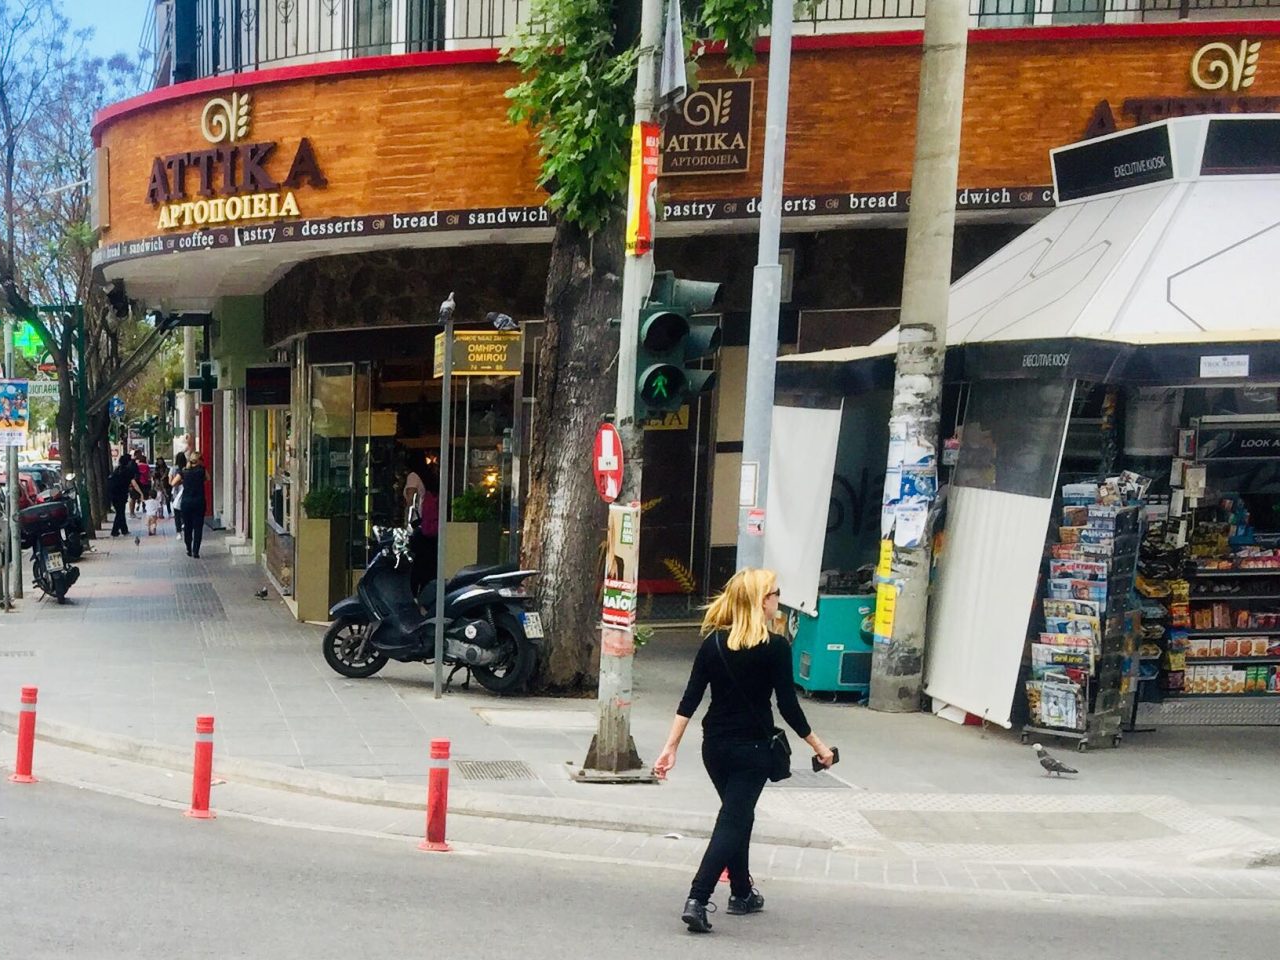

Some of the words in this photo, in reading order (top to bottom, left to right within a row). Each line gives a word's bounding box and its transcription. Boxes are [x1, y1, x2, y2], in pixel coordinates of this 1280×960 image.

[157, 191, 300, 229] ΑΡΤΟΠΟΙΕΙΑ
[663, 202, 716, 221] pastry
[746, 197, 817, 213] deerts
[849, 189, 898, 208] bread
[959, 188, 1011, 205] dwich
[129, 237, 163, 254] sandwich
[179, 232, 214, 248] coffee
[301, 218, 364, 236] desserts
[392, 212, 438, 229] bread
[468, 206, 548, 225] sandwich
[467, 353, 507, 362] OMIROU
[1241, 439, 1271, 448] LOOK
